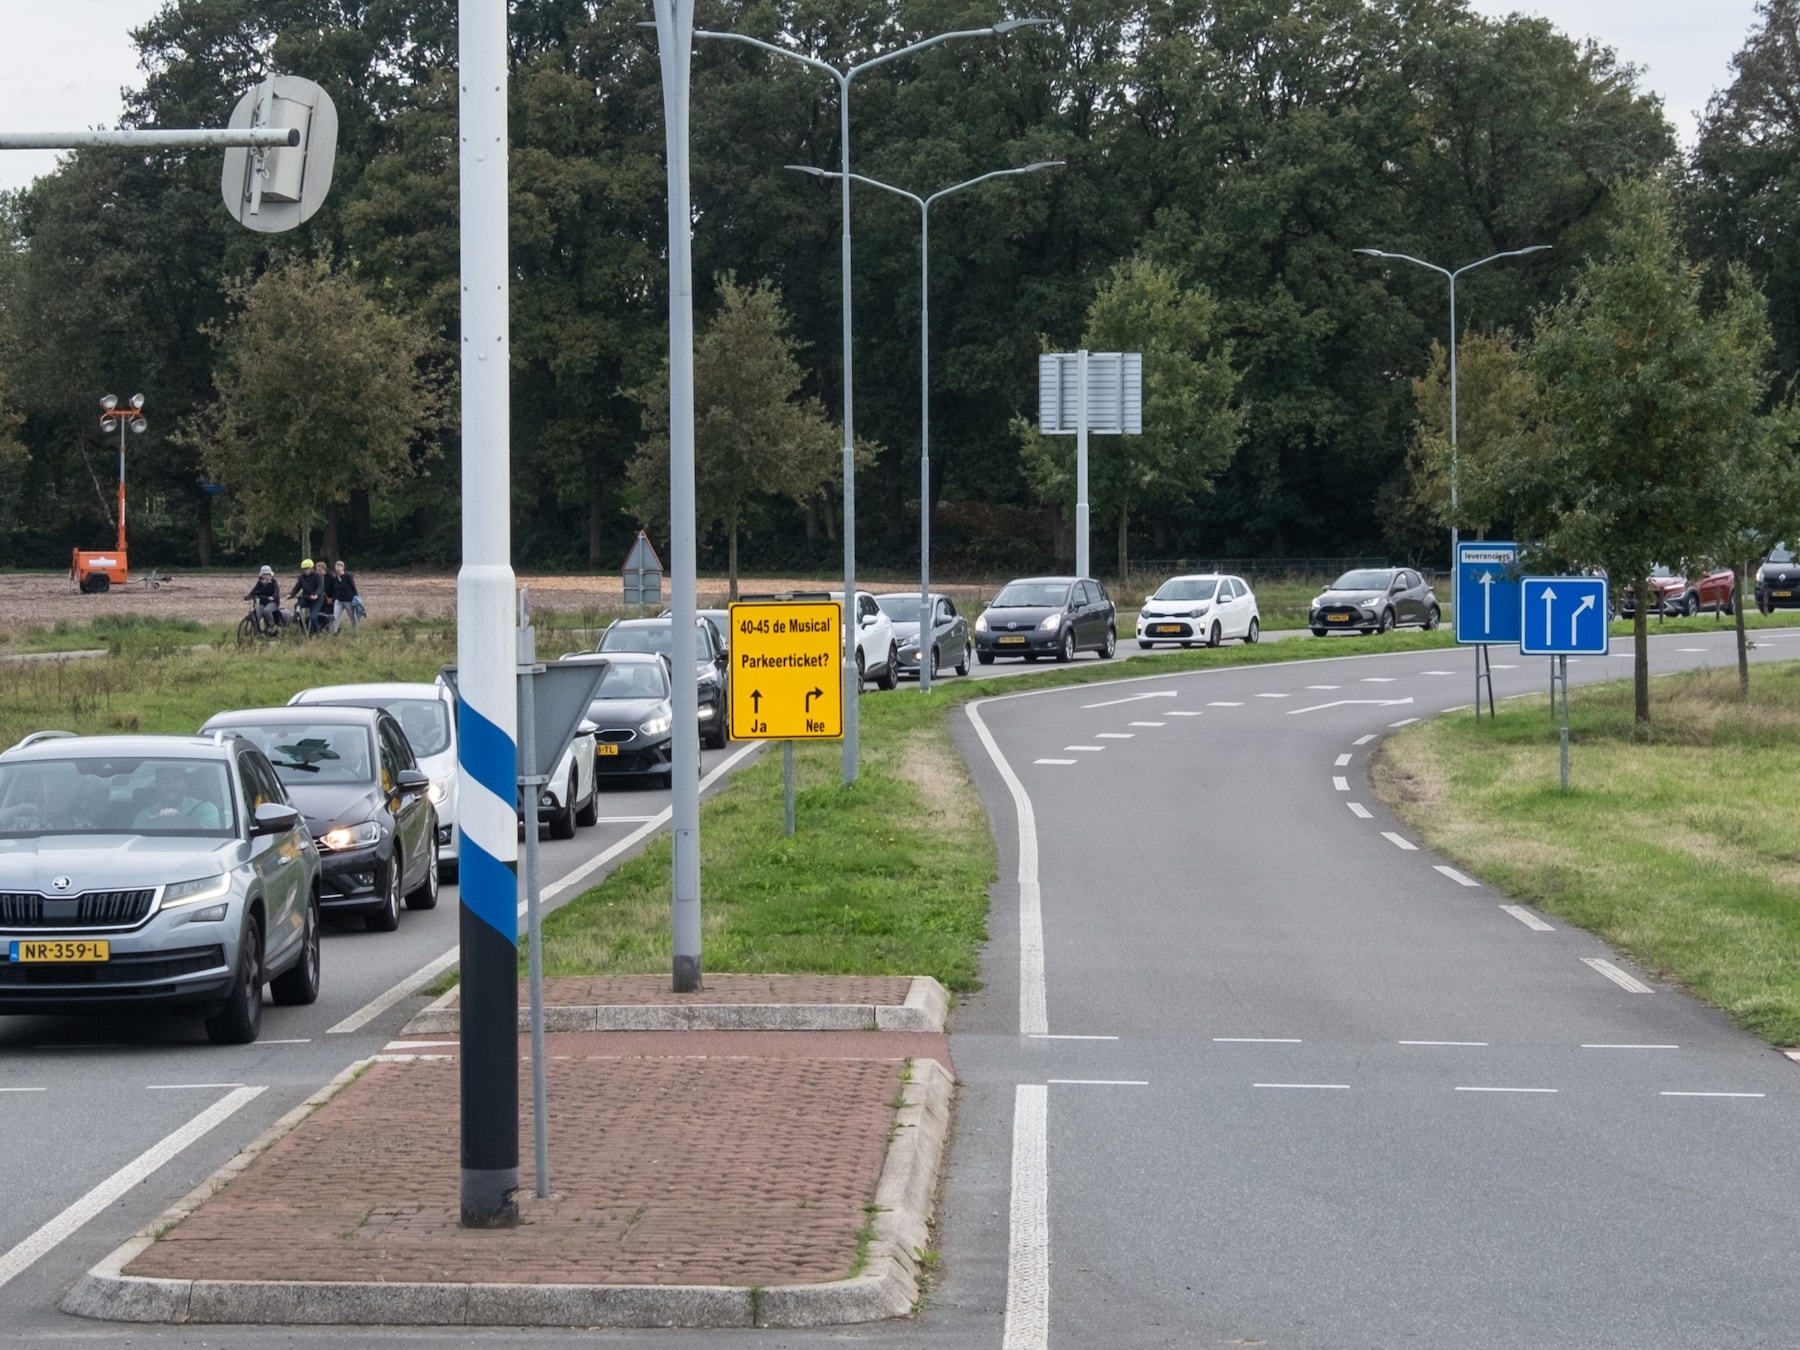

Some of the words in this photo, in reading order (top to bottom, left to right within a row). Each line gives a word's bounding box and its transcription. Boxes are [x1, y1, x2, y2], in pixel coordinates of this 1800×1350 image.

[773, 618, 786, 634] de
[741, 652, 830, 669] Parkeerticket?
[751, 719, 767, 733] Ja
[806, 718, 825, 733] Nee
[25, 943, 103, 959] NR-359-L
